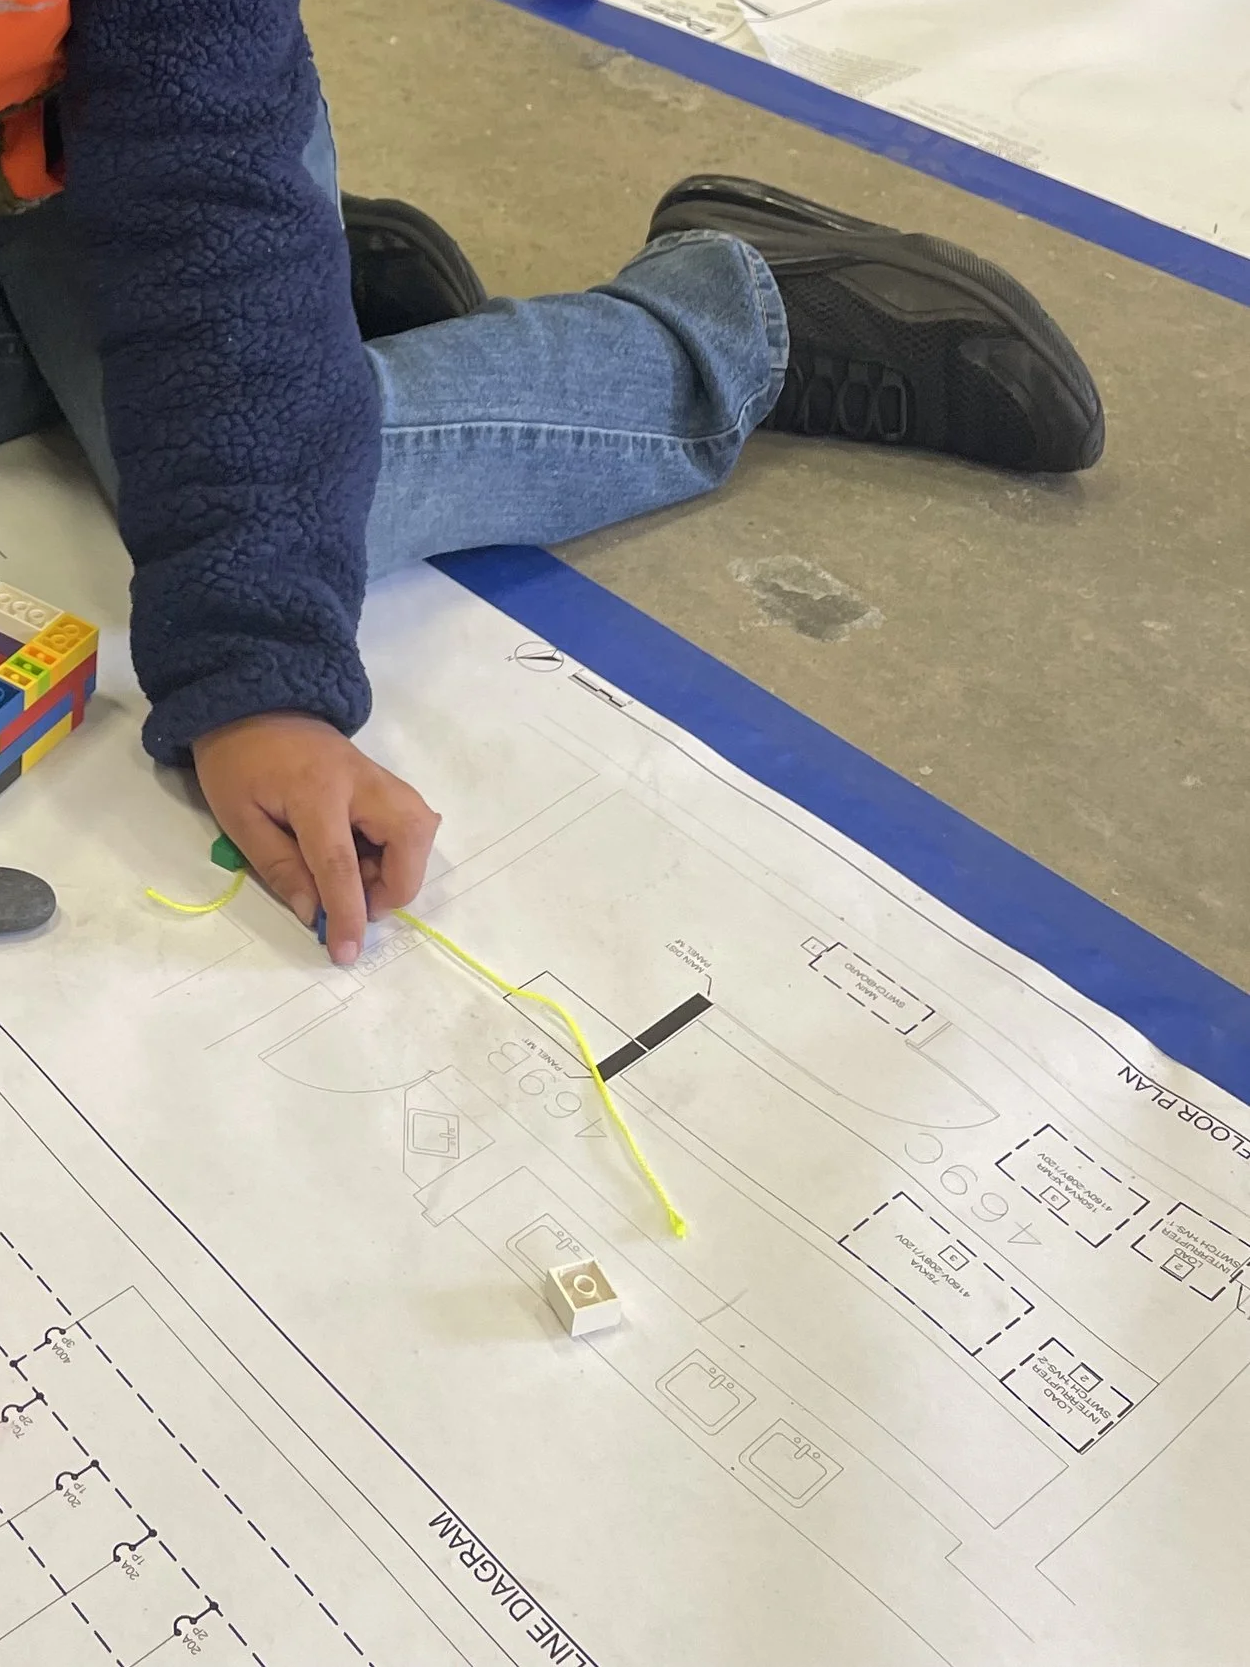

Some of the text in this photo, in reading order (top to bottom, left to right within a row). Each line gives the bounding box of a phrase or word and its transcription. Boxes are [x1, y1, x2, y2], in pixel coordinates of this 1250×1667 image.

[665, 942, 705, 974] MAIN DIST
[688, 946, 712, 969] PANEL
[844, 963, 906, 1009] SWITCHBOARD
[855, 982, 879, 1001] MAIN
[538, 1048, 562, 1072] PANEL
[488, 1041, 608, 1138] 469B
[1117, 1065, 1250, 1161] FLOOR PLAN
[904, 1132, 1042, 1245] 469C
[1035, 1162, 1099, 1214] 150KVA XFMR
[1161, 1226, 1232, 1276] INTERRUPTER
[1173, 1246, 1206, 1269] LOAD
[1199, 1240, 1242, 1272] SWITCH
[909, 1257, 941, 1286] 75KVA
[51, 1342, 71, 1364] 400A
[61, 1336, 75, 1349] 3P
[1032, 1362, 1102, 1426] INTERRUPTER
[1043, 1387, 1074, 1416] LOAD
[1071, 1384, 1111, 1420] SWITCH
[19, 1414, 33, 1427] 2P
[63, 1488, 82, 1508] 20A
[74, 1482, 87, 1495] 1P
[121, 1559, 140, 1581] 20A
[131, 1553, 145, 1566] 1P
[428, 1510, 535, 1622] DIAGRAM
[182, 1633, 202, 1656] 20A
[192, 1627, 209, 1641] 2P
